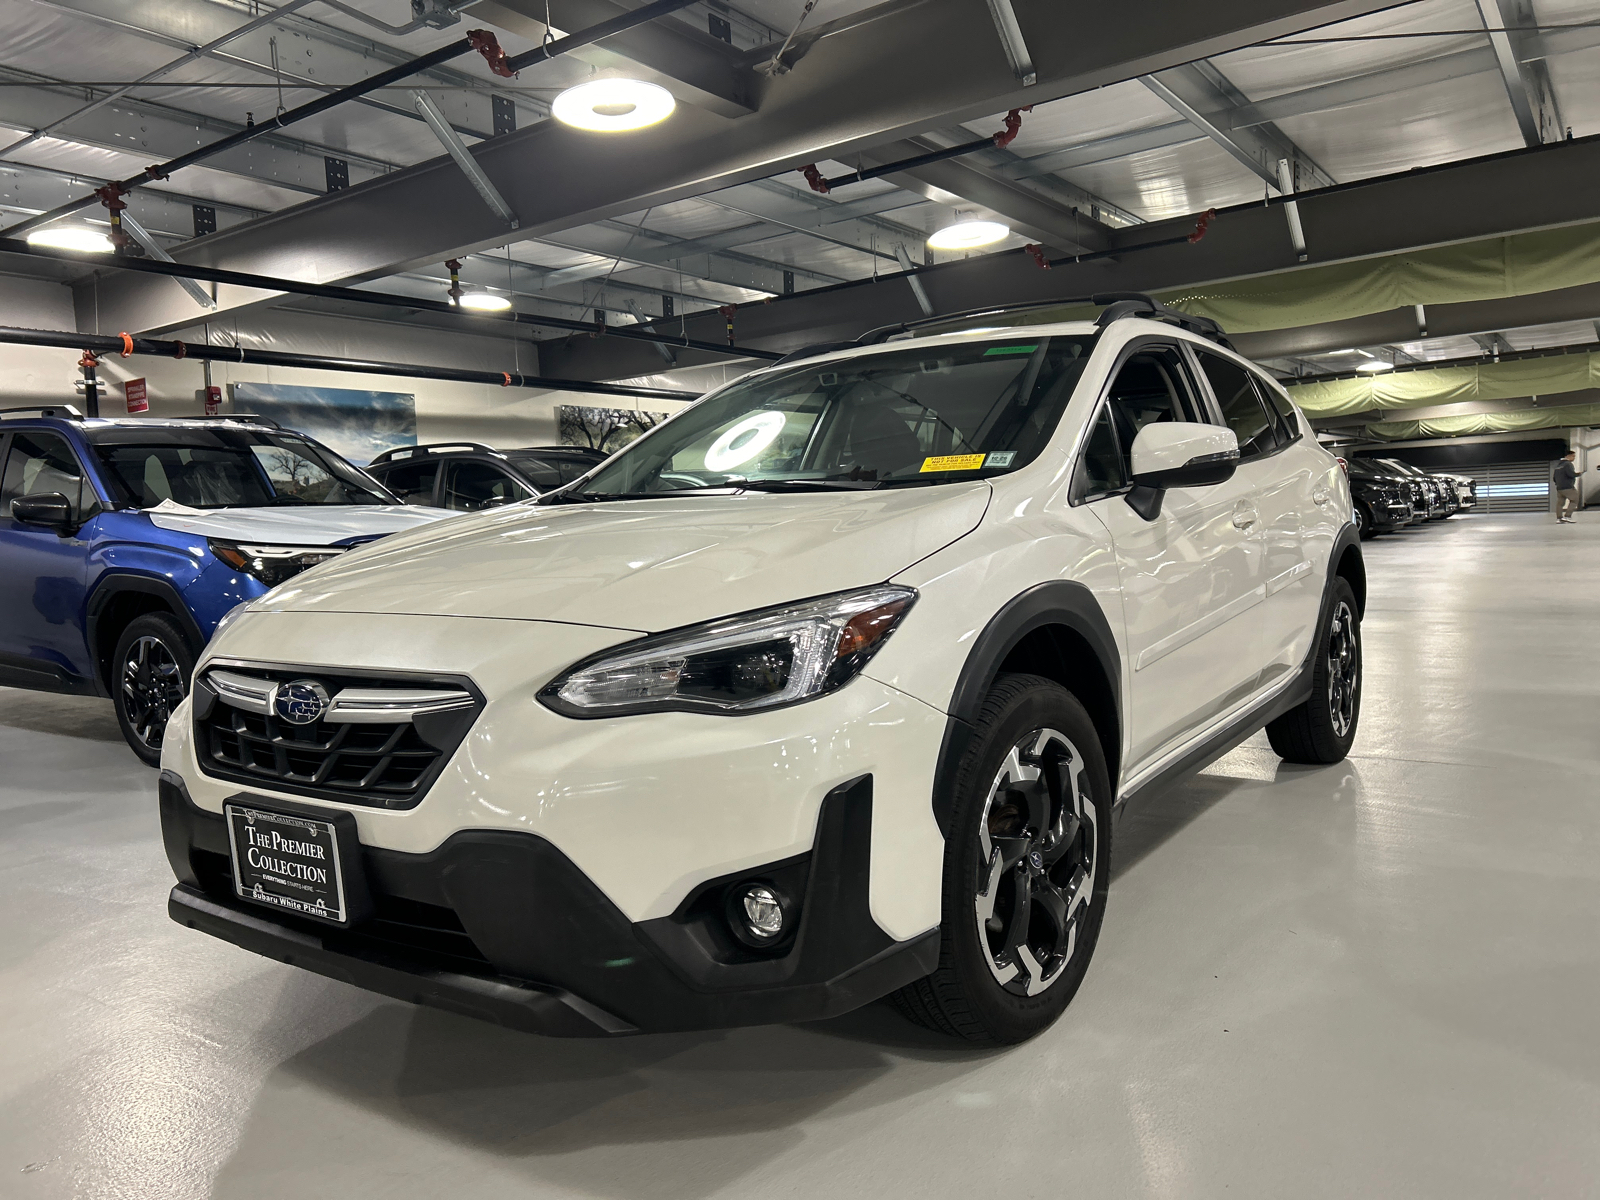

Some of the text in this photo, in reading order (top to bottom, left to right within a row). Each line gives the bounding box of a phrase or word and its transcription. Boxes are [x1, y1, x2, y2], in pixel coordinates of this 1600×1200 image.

[271, 830, 325, 860] PREMIER
[248, 847, 327, 884] COLLECTION
[262, 873, 287, 886] EVERYTHING
[252, 891, 328, 917] Subaru White Plains
